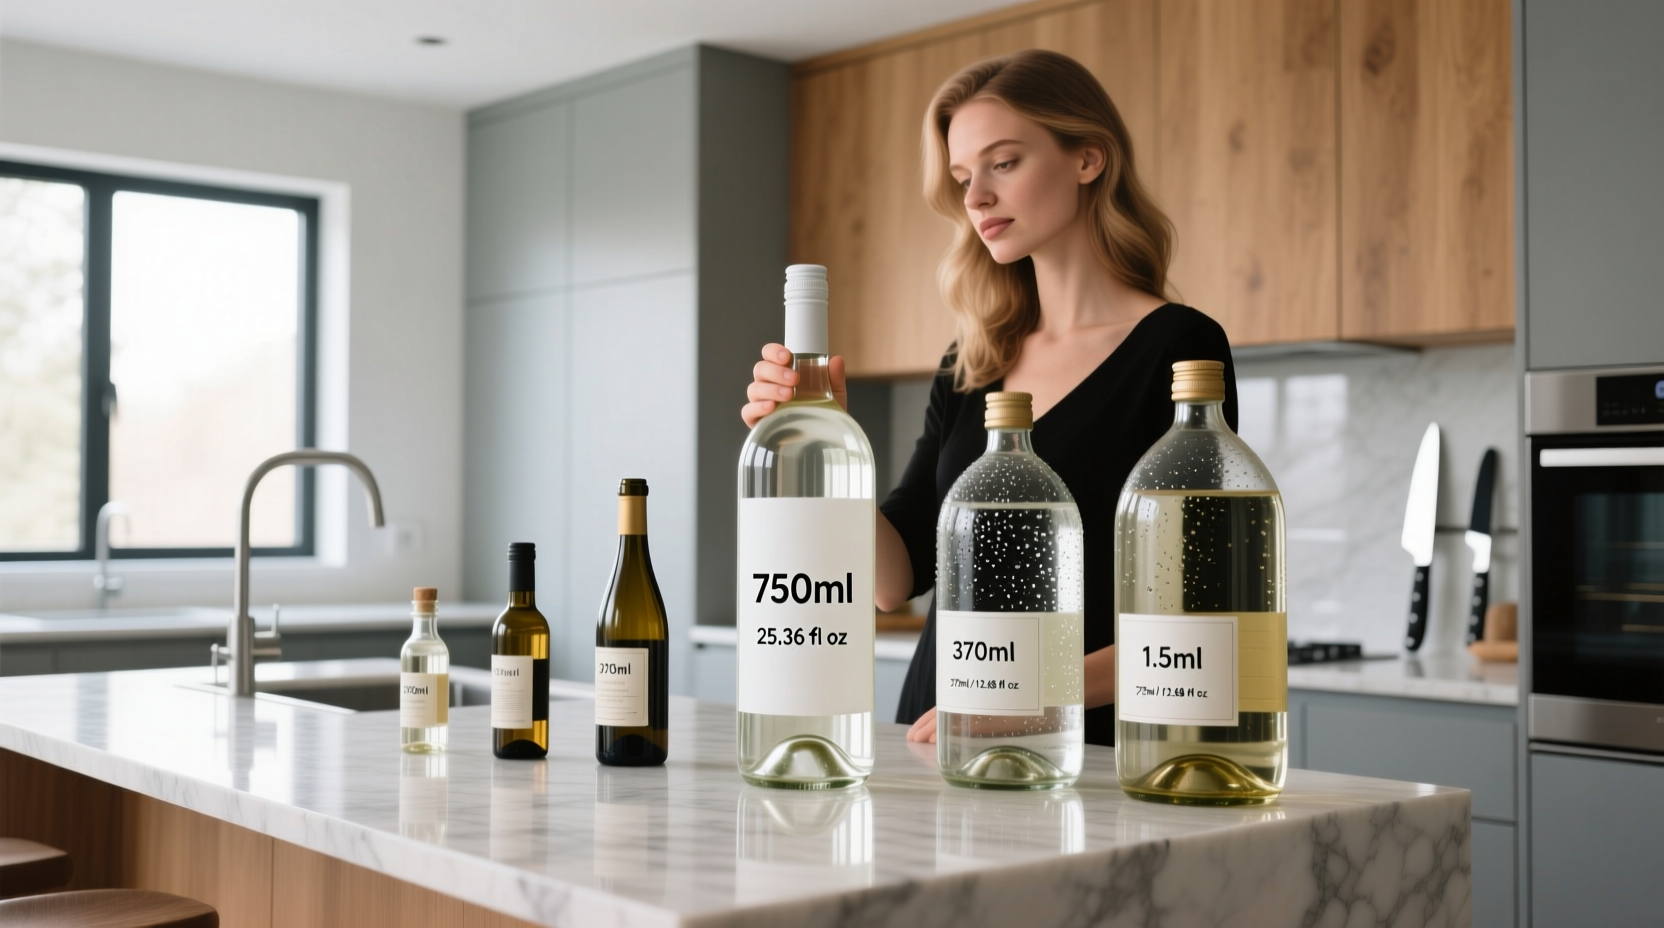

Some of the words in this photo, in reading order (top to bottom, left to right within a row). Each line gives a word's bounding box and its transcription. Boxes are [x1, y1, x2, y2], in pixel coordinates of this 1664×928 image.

[752, 572, 853, 604] 750ml
[757, 627, 805, 646] 25.36
[808, 626, 822, 646] fl
[827, 632, 848, 646] oz
[952, 640, 1015, 662] 370ml
[1142, 645, 1203, 670] 1.5ml
[1008, 682, 1020, 690] oz
[1197, 690, 1209, 698] oz
